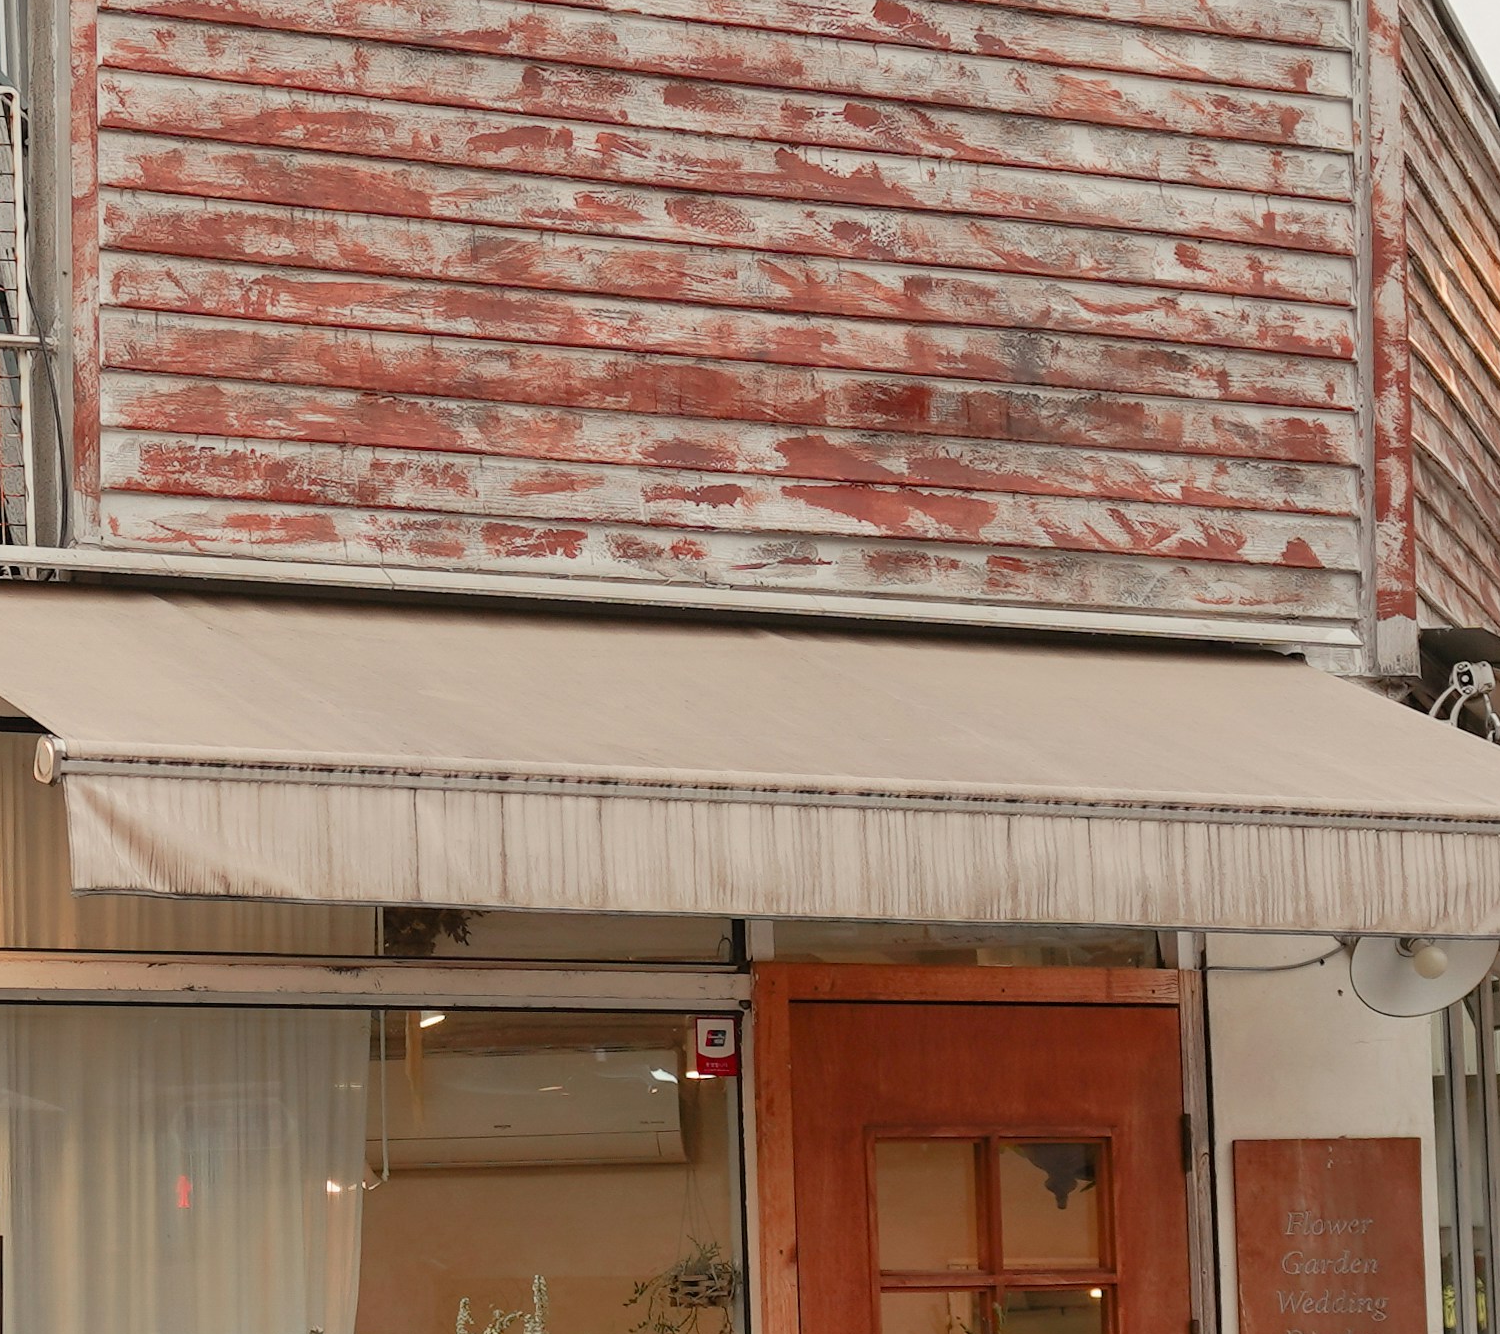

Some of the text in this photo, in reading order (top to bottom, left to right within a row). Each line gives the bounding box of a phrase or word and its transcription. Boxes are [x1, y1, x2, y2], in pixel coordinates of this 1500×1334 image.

[1284, 1210, 1374, 1236] Flower
[1281, 1250, 1380, 1275] Garden
[1275, 1289, 1390, 1322] Wedding
